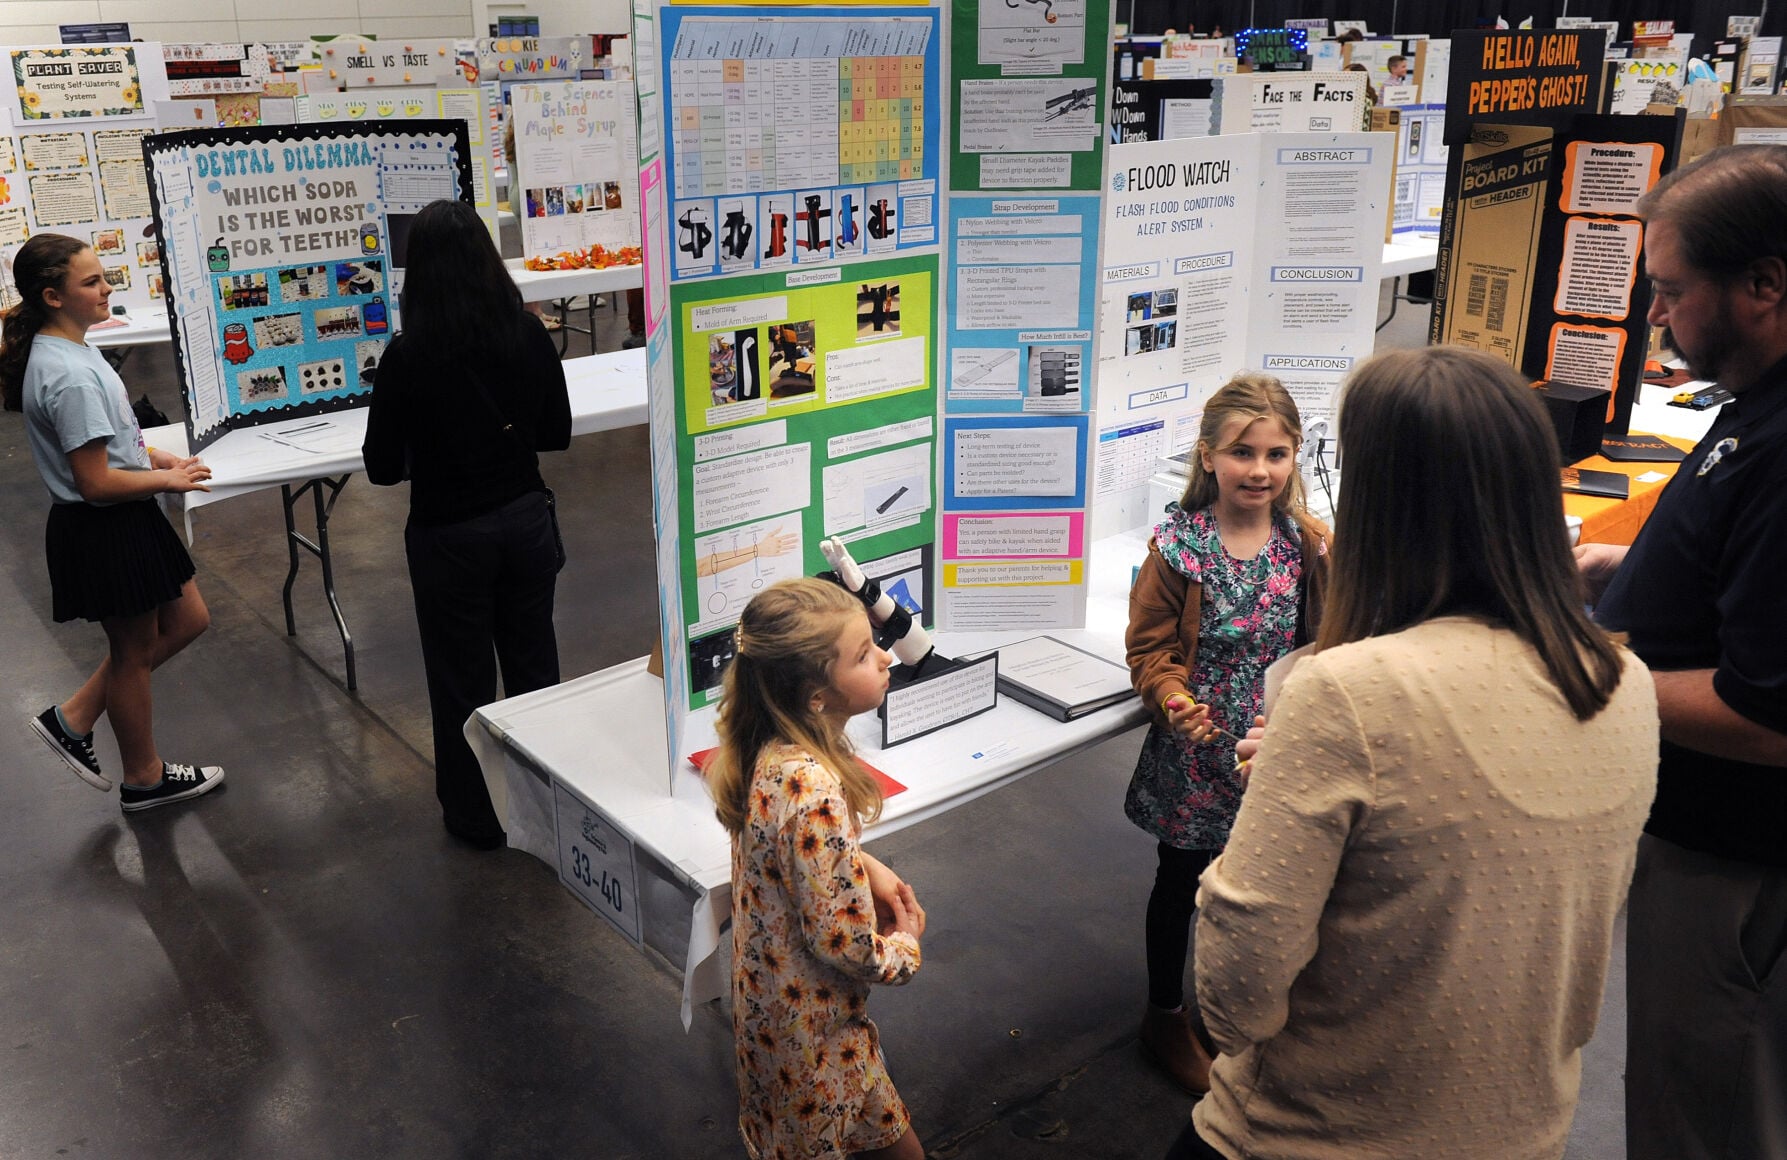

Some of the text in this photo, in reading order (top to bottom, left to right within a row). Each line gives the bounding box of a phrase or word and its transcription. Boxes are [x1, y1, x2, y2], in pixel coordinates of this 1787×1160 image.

[1482, 35, 1580, 70] HELLO AGAIN,
[347, 54, 428, 68] SMELL VS TASTE
[498, 55, 568, 74] CONUNDRUM
[27, 61, 123, 77] PLANT SAVER
[37, 79, 120, 92] Testing Self-Watering
[520, 82, 613, 102] The Science
[64, 93, 97, 102] Systems
[1116, 86, 1138, 104] Down
[1469, 75, 1588, 114] PEPPER'S GHOST!
[542, 100, 588, 118] Behind
[1123, 108, 1146, 122] Down
[526, 118, 616, 141] Maple Syrup
[1312, 120, 1328, 128] Data
[1123, 129, 1148, 142] Hands
[195, 141, 373, 178] DENTAL DILEMMA
[1294, 152, 1354, 161] ABSTRACT
[1591, 148, 1636, 158] Procedure:
[1464, 156, 1548, 191] BOARD KIT
[1466, 160, 1493, 175] Project
[1128, 160, 1230, 192] FLOOD WATCH
[222, 180, 358, 206] WHICH SODA
[1490, 188, 1529, 203] HEADER
[994, 204, 1011, 212] Strap
[1116, 195, 1235, 218] FLASH FLOOD CONDITIONS
[218, 203, 366, 233] IS THE WORST
[1137, 218, 1203, 236] ALERT SYSTEM
[1588, 222, 1620, 232] Results:
[230, 228, 359, 258] FOR TEETH?
[1107, 255, 1226, 280] MATERIALS PROCEDURE
[1280, 270, 1353, 279] CONCLUSION
[1440, 250, 1449, 284] HEADER
[788, 271, 838, 284] Base Development
[696, 307, 710, 316] Heat
[1434, 302, 1442, 315] KIT
[704, 320, 717, 329] Mold
[728, 317, 741, 325] Arm
[742, 314, 768, 324] Required
[1562, 328, 1608, 340] Conclusion:
[1269, 358, 1347, 369] APPLICATIONS
[1149, 390, 1168, 402] DATA
[699, 434, 733, 445] 3-D Printing
[706, 440, 760, 457] 3-D Model Required
[572, 846, 622, 912] 33-40
